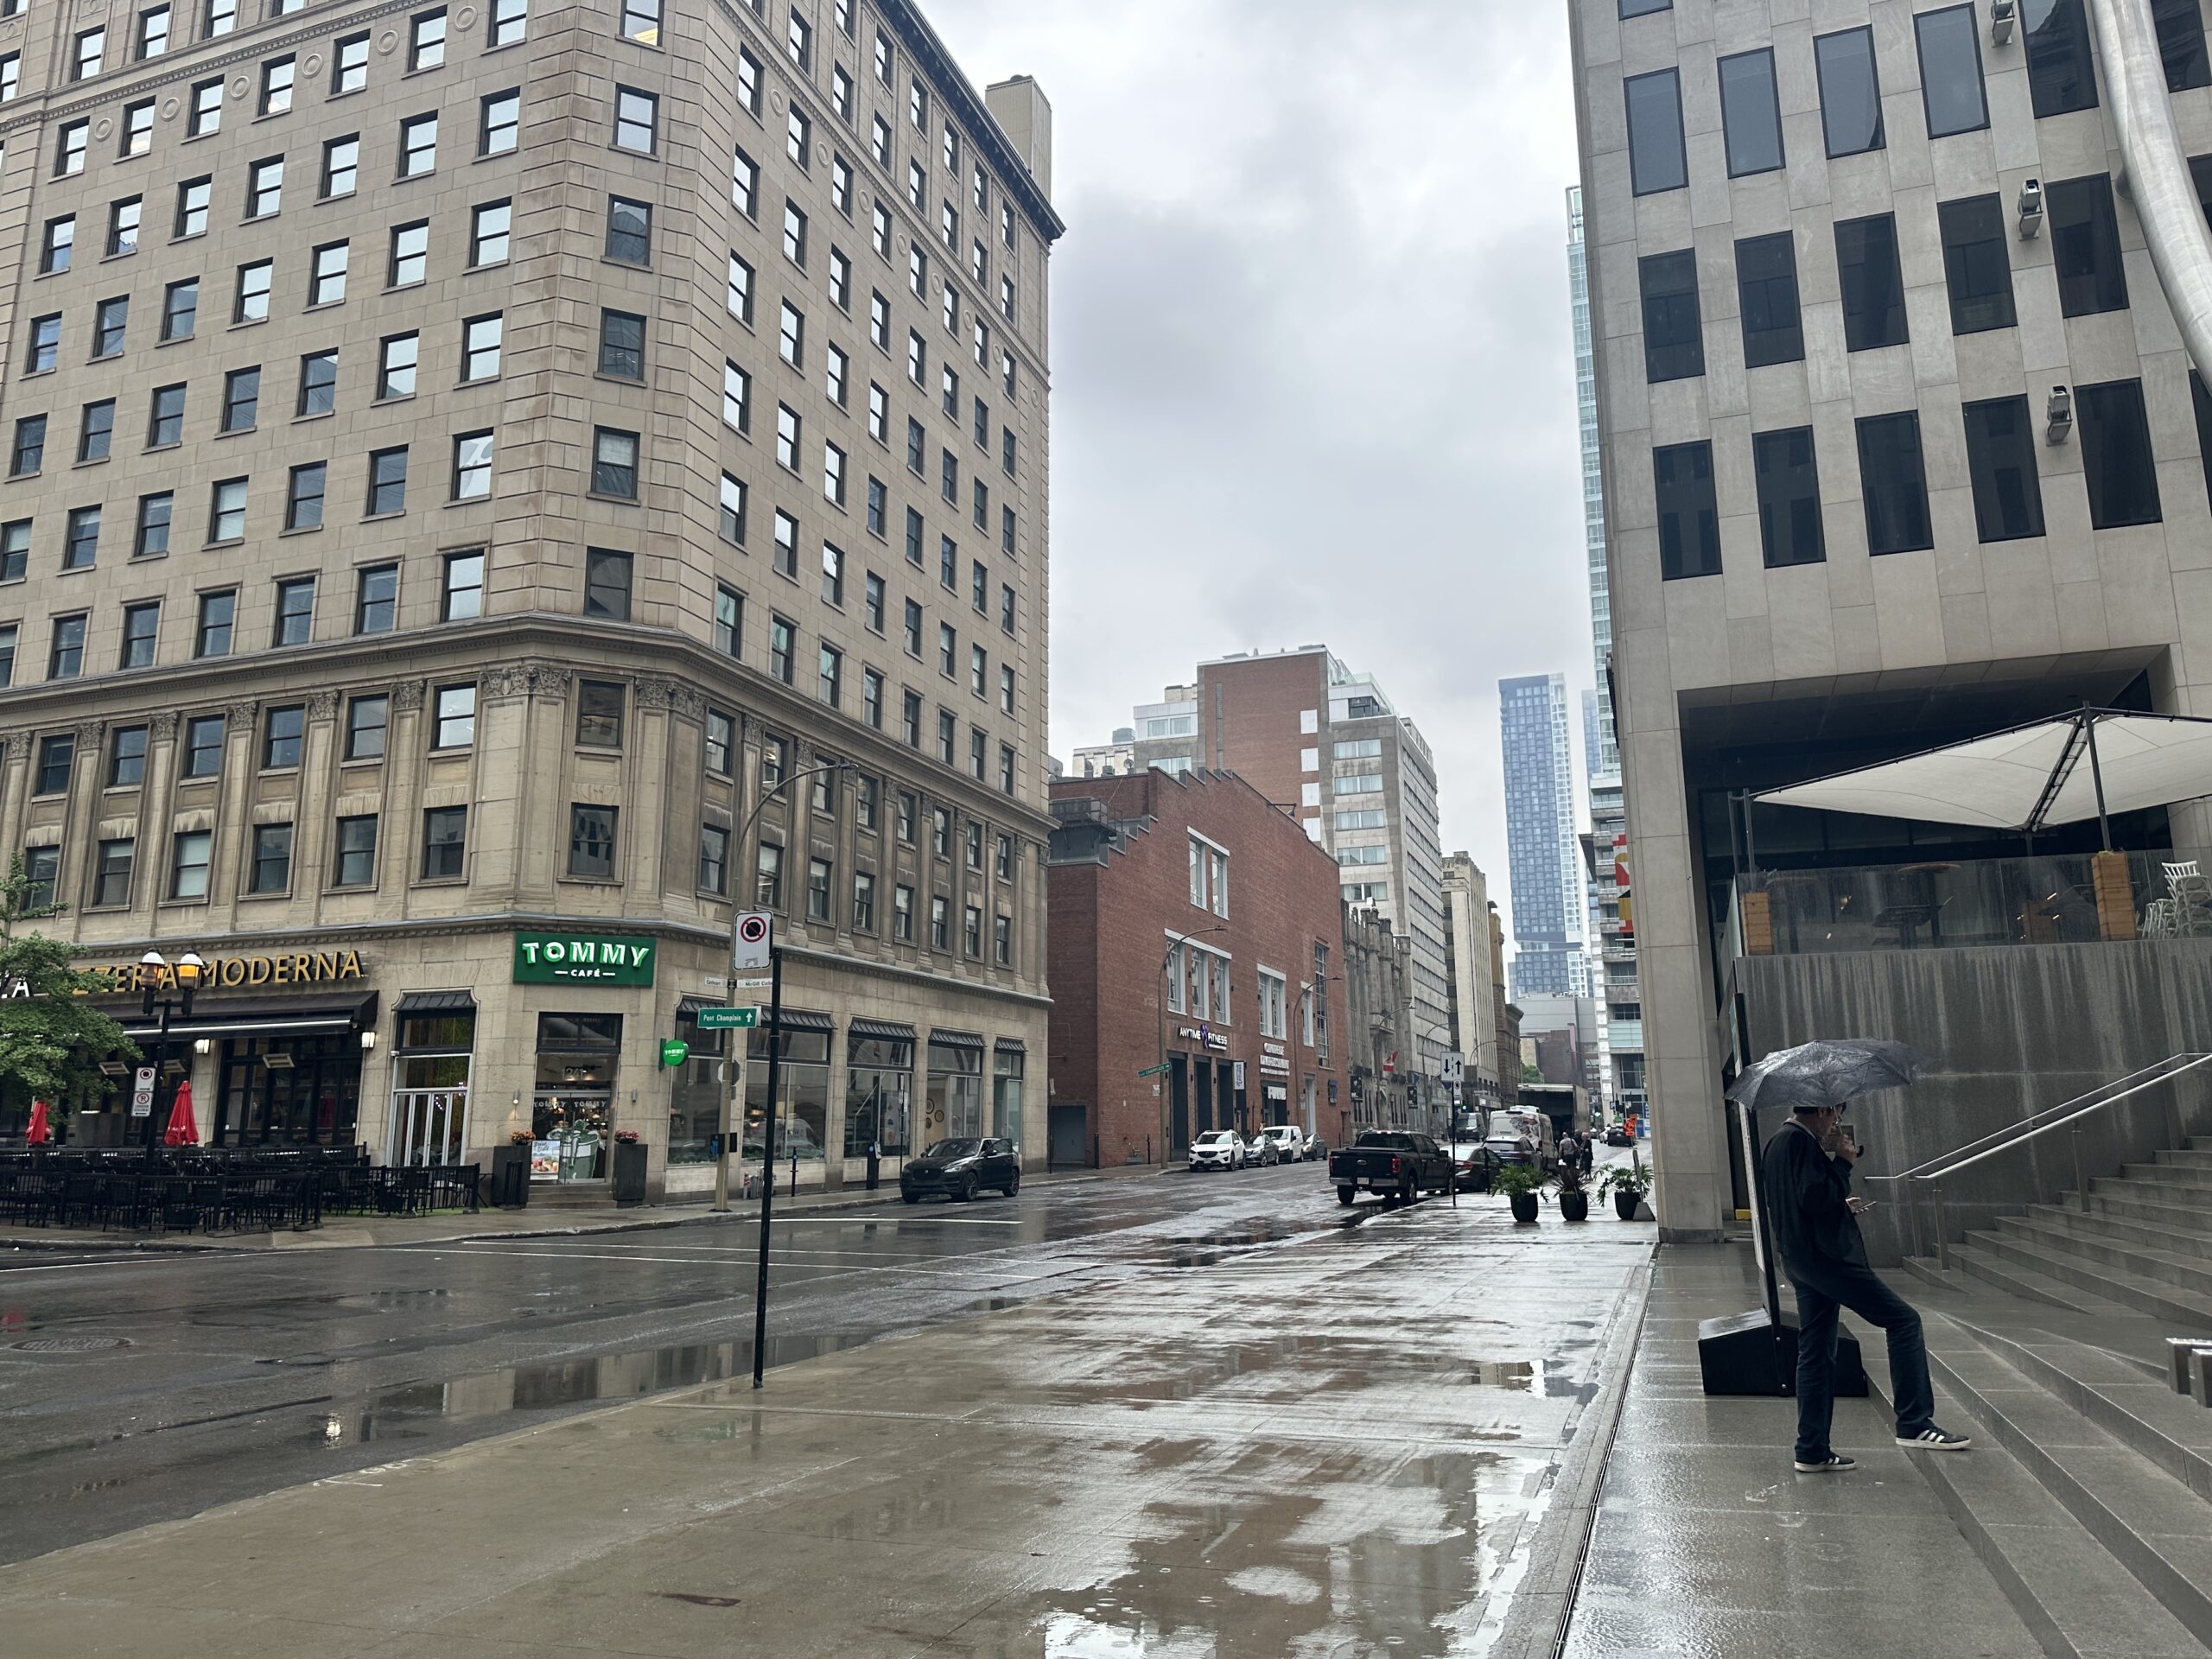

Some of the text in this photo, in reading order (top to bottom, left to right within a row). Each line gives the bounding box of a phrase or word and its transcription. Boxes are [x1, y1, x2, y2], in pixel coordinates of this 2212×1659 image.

[522, 941, 650, 968] TOMMY
[203, 950, 362, 988] MODERNA
[570, 968, 601, 977] CAFÉ
[716, 1014, 741, 1022] Champlain
[1179, 1027, 1228, 1046] ANYTIME FITNESS
